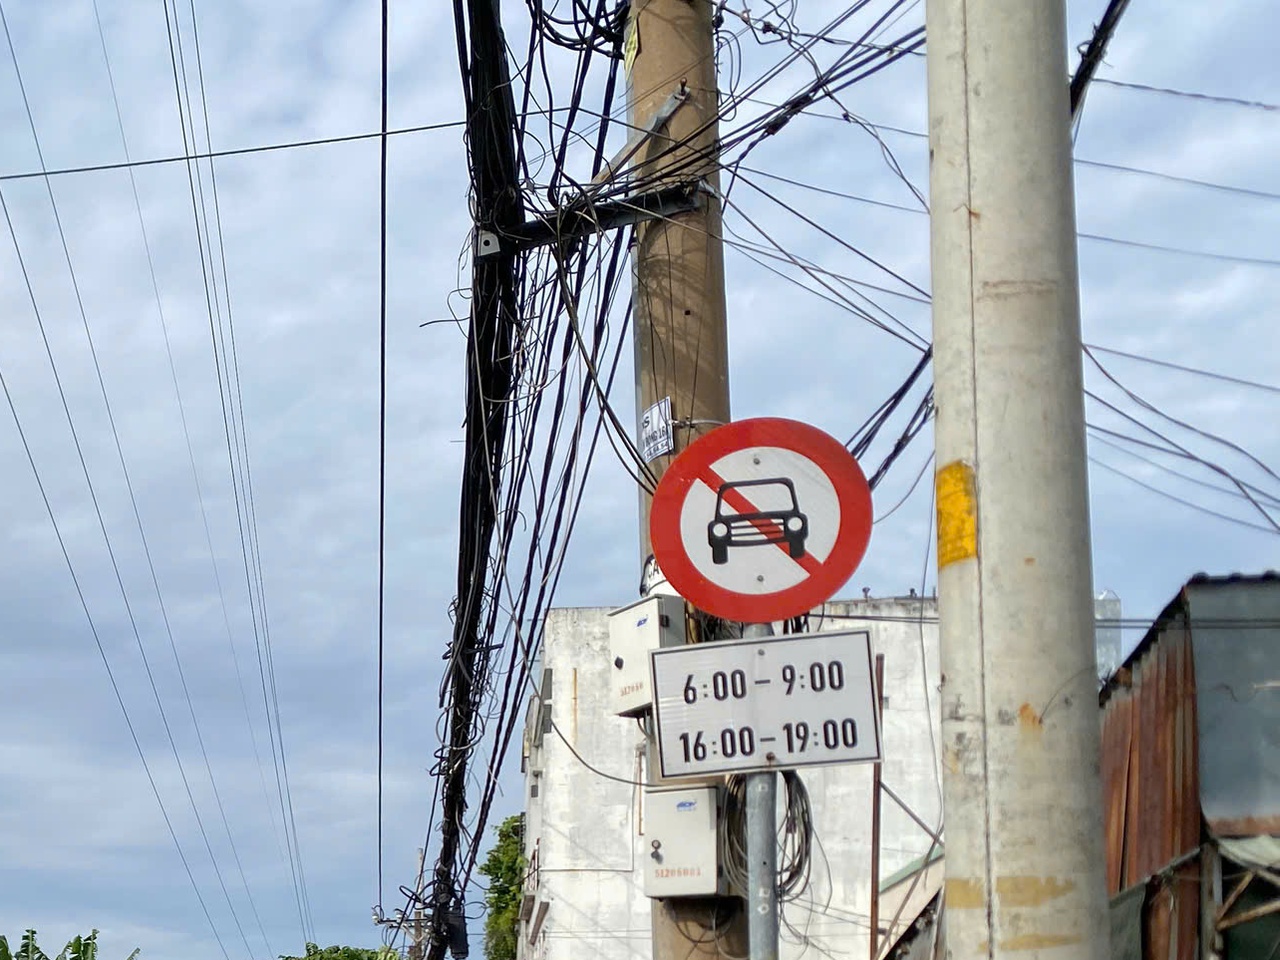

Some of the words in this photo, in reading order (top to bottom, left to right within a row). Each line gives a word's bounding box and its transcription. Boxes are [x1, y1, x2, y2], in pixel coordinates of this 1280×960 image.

[683, 669, 747, 705] 6:00
[782, 660, 844, 696] 9:00
[679, 726, 755, 763] 16:00
[782, 718, 858, 753] 19:00
